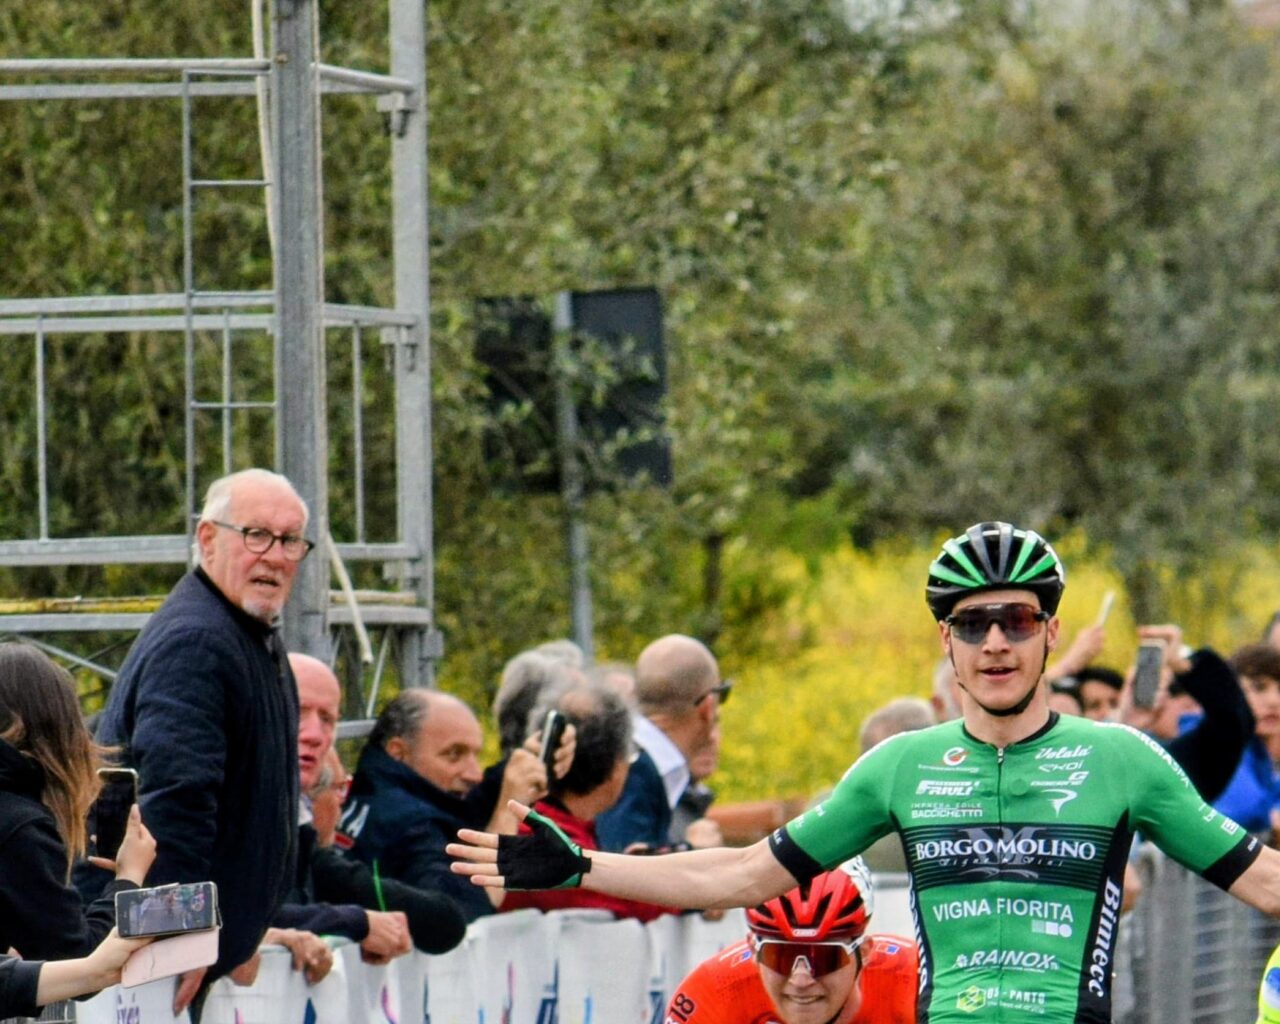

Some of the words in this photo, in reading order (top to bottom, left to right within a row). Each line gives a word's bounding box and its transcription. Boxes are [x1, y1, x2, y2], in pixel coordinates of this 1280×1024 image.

[915, 839, 993, 860] BORGO
[997, 838, 1096, 860] MOLINO
[933, 898, 992, 921] VIGNA
[997, 898, 1073, 923] FIORITA
[1088, 879, 1121, 998] Bimecc
[970, 949, 1055, 969] RAINOX
